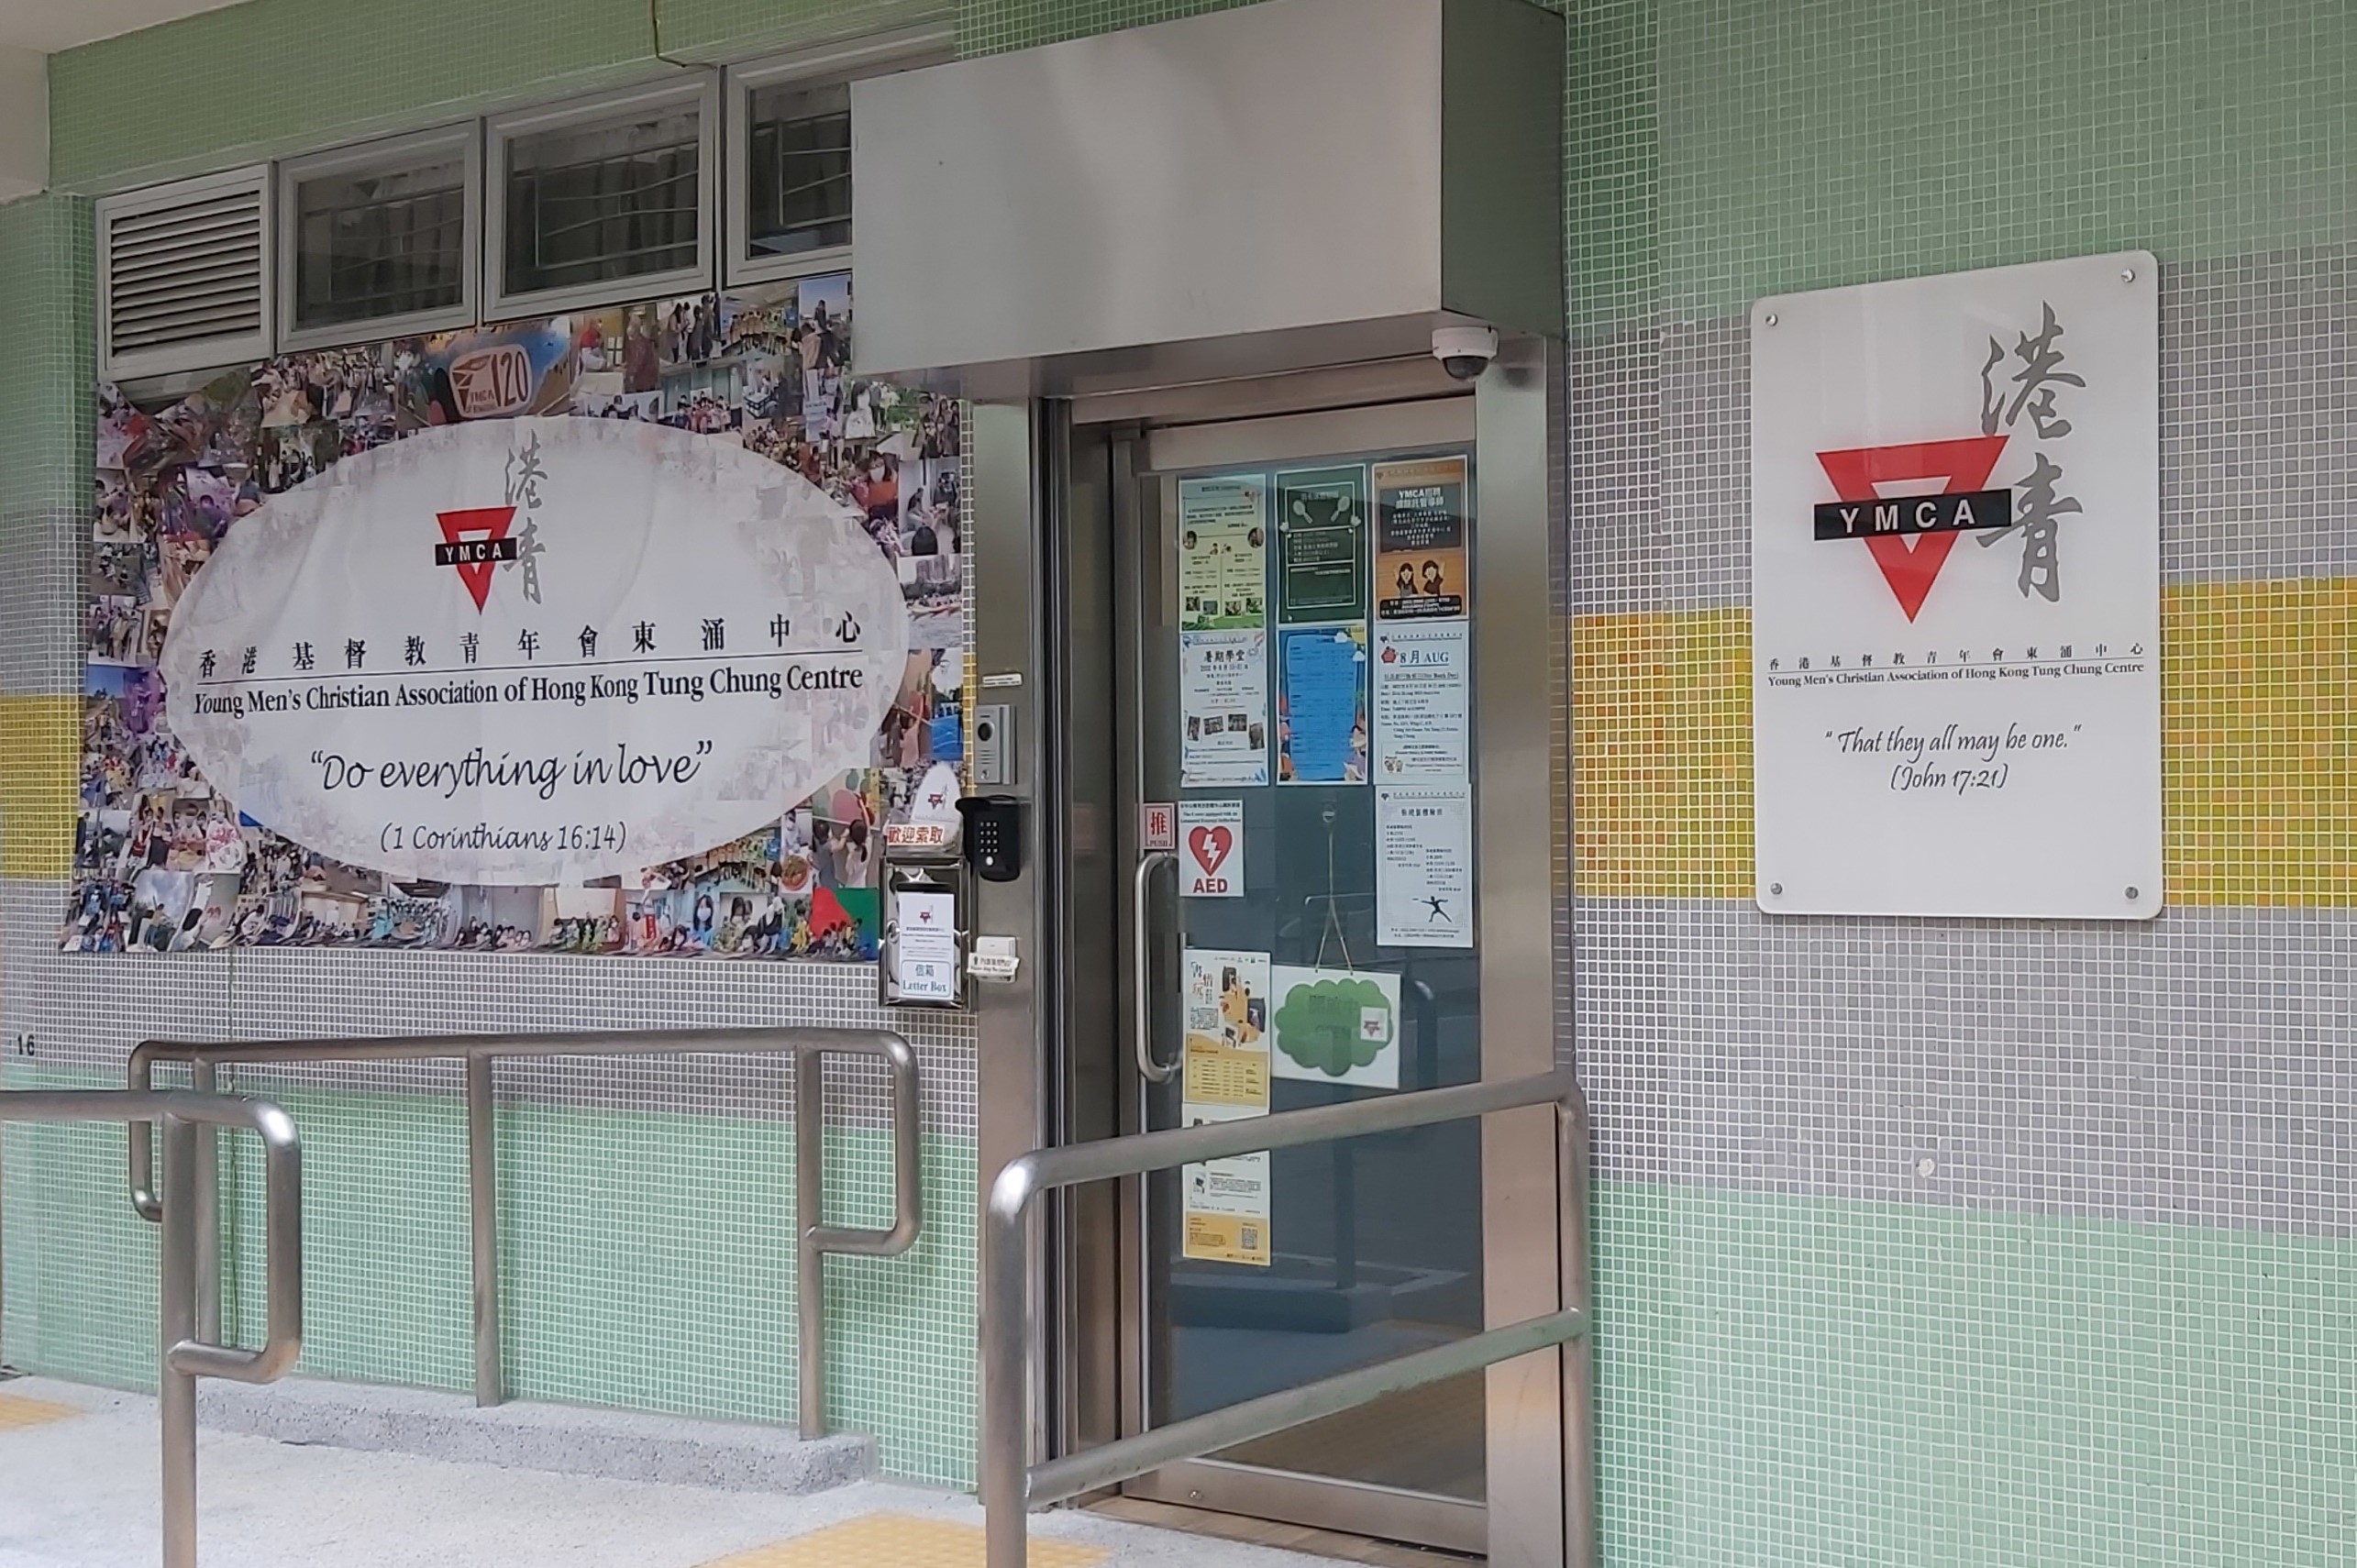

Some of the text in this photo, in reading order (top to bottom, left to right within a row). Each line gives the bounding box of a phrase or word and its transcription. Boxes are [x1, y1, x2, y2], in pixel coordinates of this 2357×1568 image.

[490, 350, 529, 407] 120
[1975, 299, 2087, 603] 港青
[502, 427, 548, 605] 港青
[1839, 499, 1975, 534] YMCA
[445, 543, 503, 562] YMCA
[198, 611, 862, 679] 香港基督教青年會東涌中心
[1400, 650, 1449, 664] 8 月 AUG
[194, 664, 864, 719] Young Men’s Christian Association of Hong Kong Tung Chung Centre
[1767, 662, 2144, 688] Young Men's Christian Association of Hong Kong Tung Chung Centre
[1886, 725, 1925, 764] they
[1929, 723, 1958, 751] all
[1957, 734, 2000, 763] may
[2005, 722, 2028, 749] be
[379, 746, 567, 801] everything
[573, 750, 613, 786] in
[1889, 760, 2008, 796] (John 17:21)
[380, 821, 627, 855] (1 Corinthians 16:14)
[1150, 812, 1167, 835] 推
[1192, 878, 1228, 894] AED
[902, 979, 946, 992] Letter Box
[17, 1033, 35, 1056] 16
